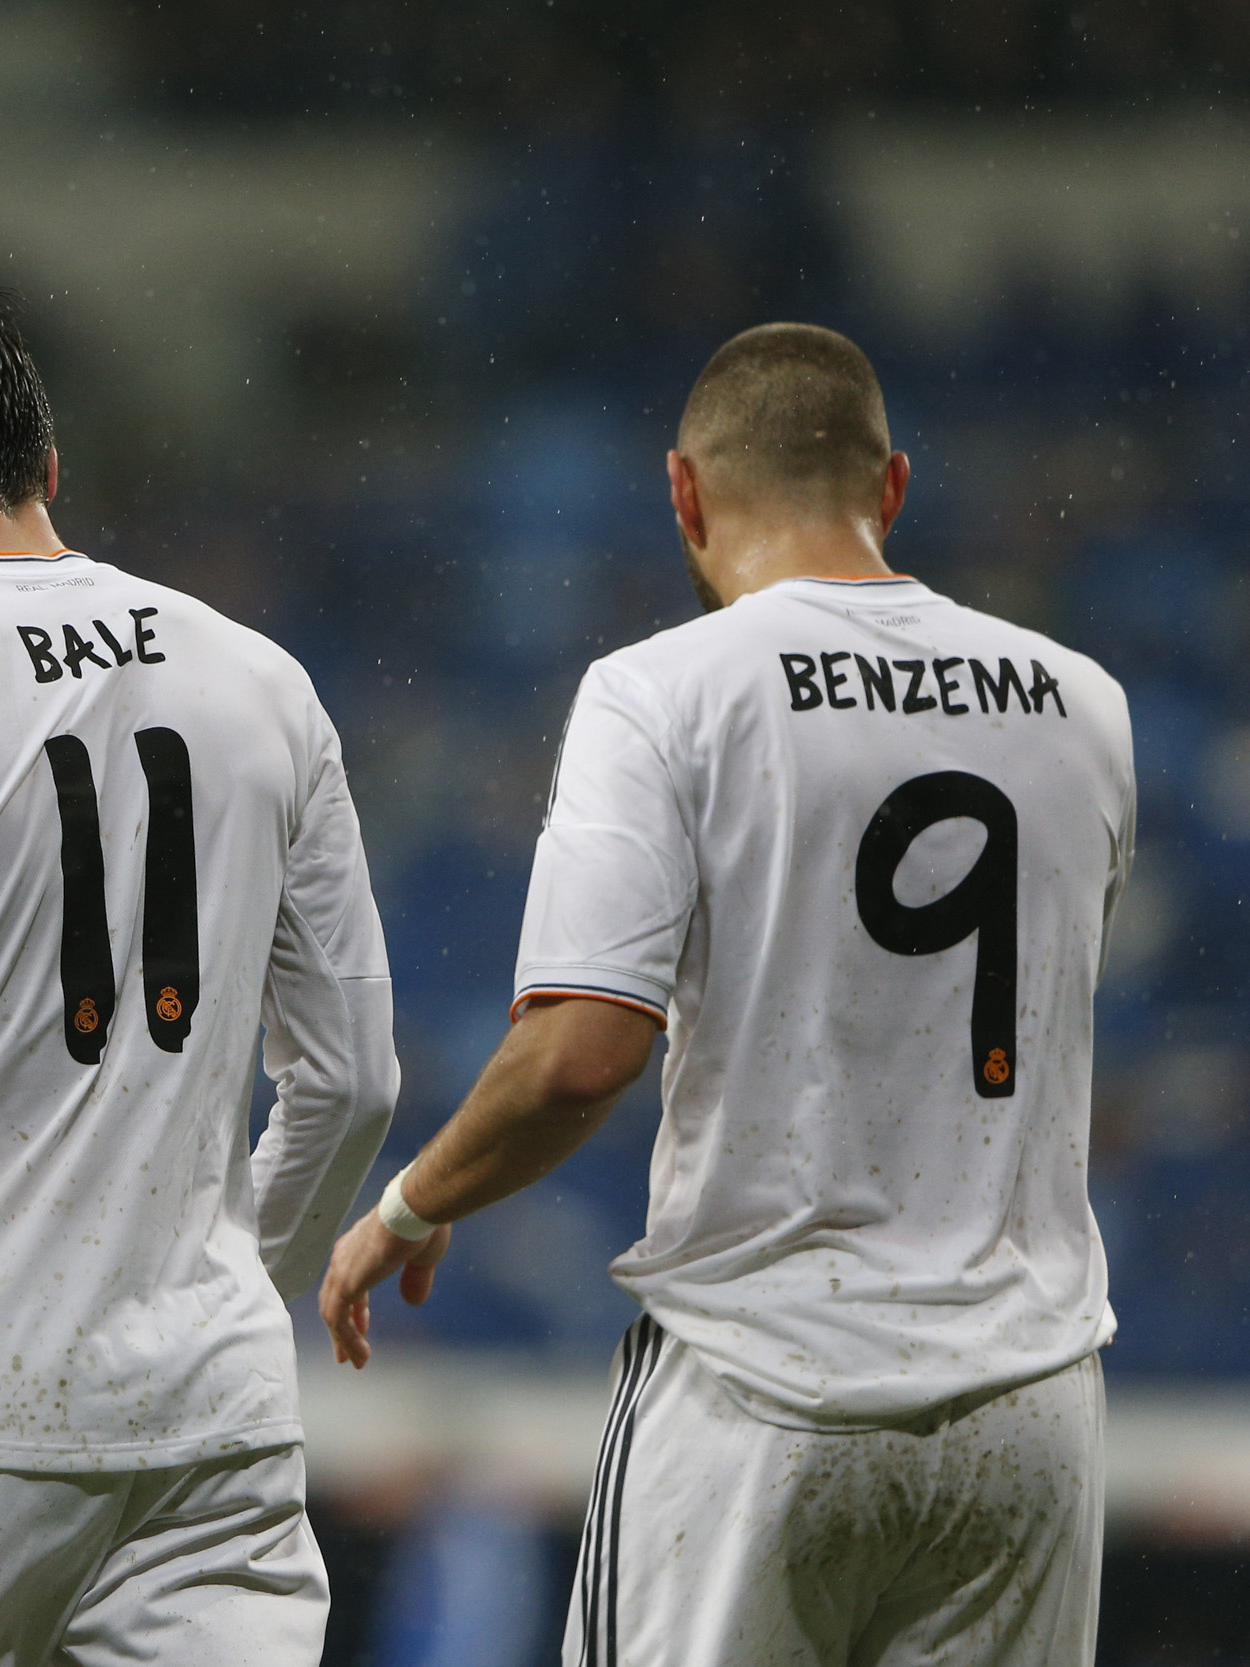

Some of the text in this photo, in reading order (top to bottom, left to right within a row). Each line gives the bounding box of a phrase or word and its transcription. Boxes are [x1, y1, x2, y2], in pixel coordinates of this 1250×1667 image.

[17, 608, 165, 682] BALE
[780, 653, 1067, 717] BENZEMA
[44, 727, 199, 1065] 11
[855, 770, 1018, 1099] 9
